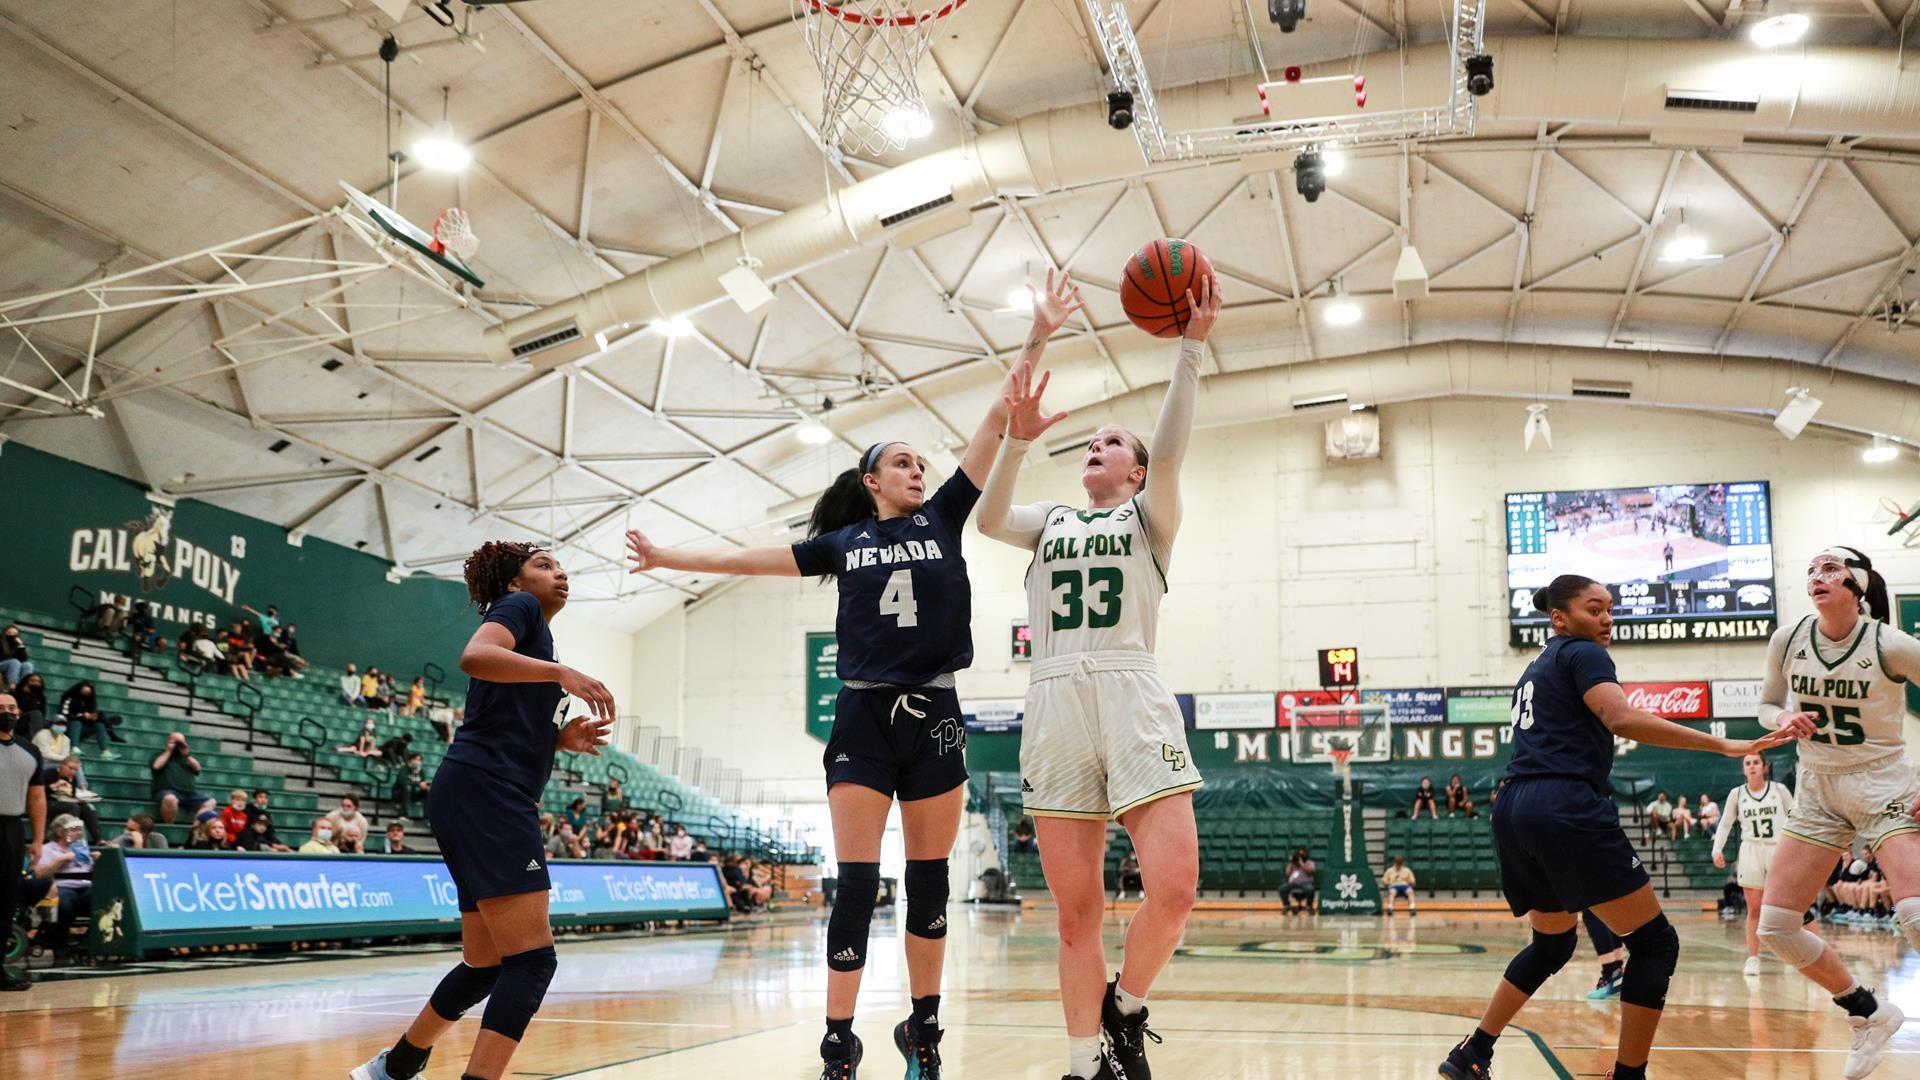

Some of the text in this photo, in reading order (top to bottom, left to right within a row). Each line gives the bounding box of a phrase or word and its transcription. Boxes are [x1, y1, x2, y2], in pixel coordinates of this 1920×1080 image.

[846, 539, 943, 571] NEVADA
[1043, 533, 1132, 565] CAL POLY
[70, 528, 241, 605] CAL POLY
[879, 569, 918, 627] 4
[1052, 567, 1124, 631] 33
[1692, 620, 1770, 639] FAMILY
[1333, 663, 1351, 682] 14
[1415, 691, 1442, 702] Sun
[1791, 674, 1871, 699] CAL POLY
[1627, 687, 1704, 714] Coca-Cola
[1499, 726, 1514, 744] 17
[1710, 721, 1727, 739] 18
[1743, 806, 1778, 818] CAL POLY
[1752, 818, 1773, 838] 13
[602, 874, 718, 902] TicketSmarter.com
[1322, 899, 1376, 910] Dignity Health
